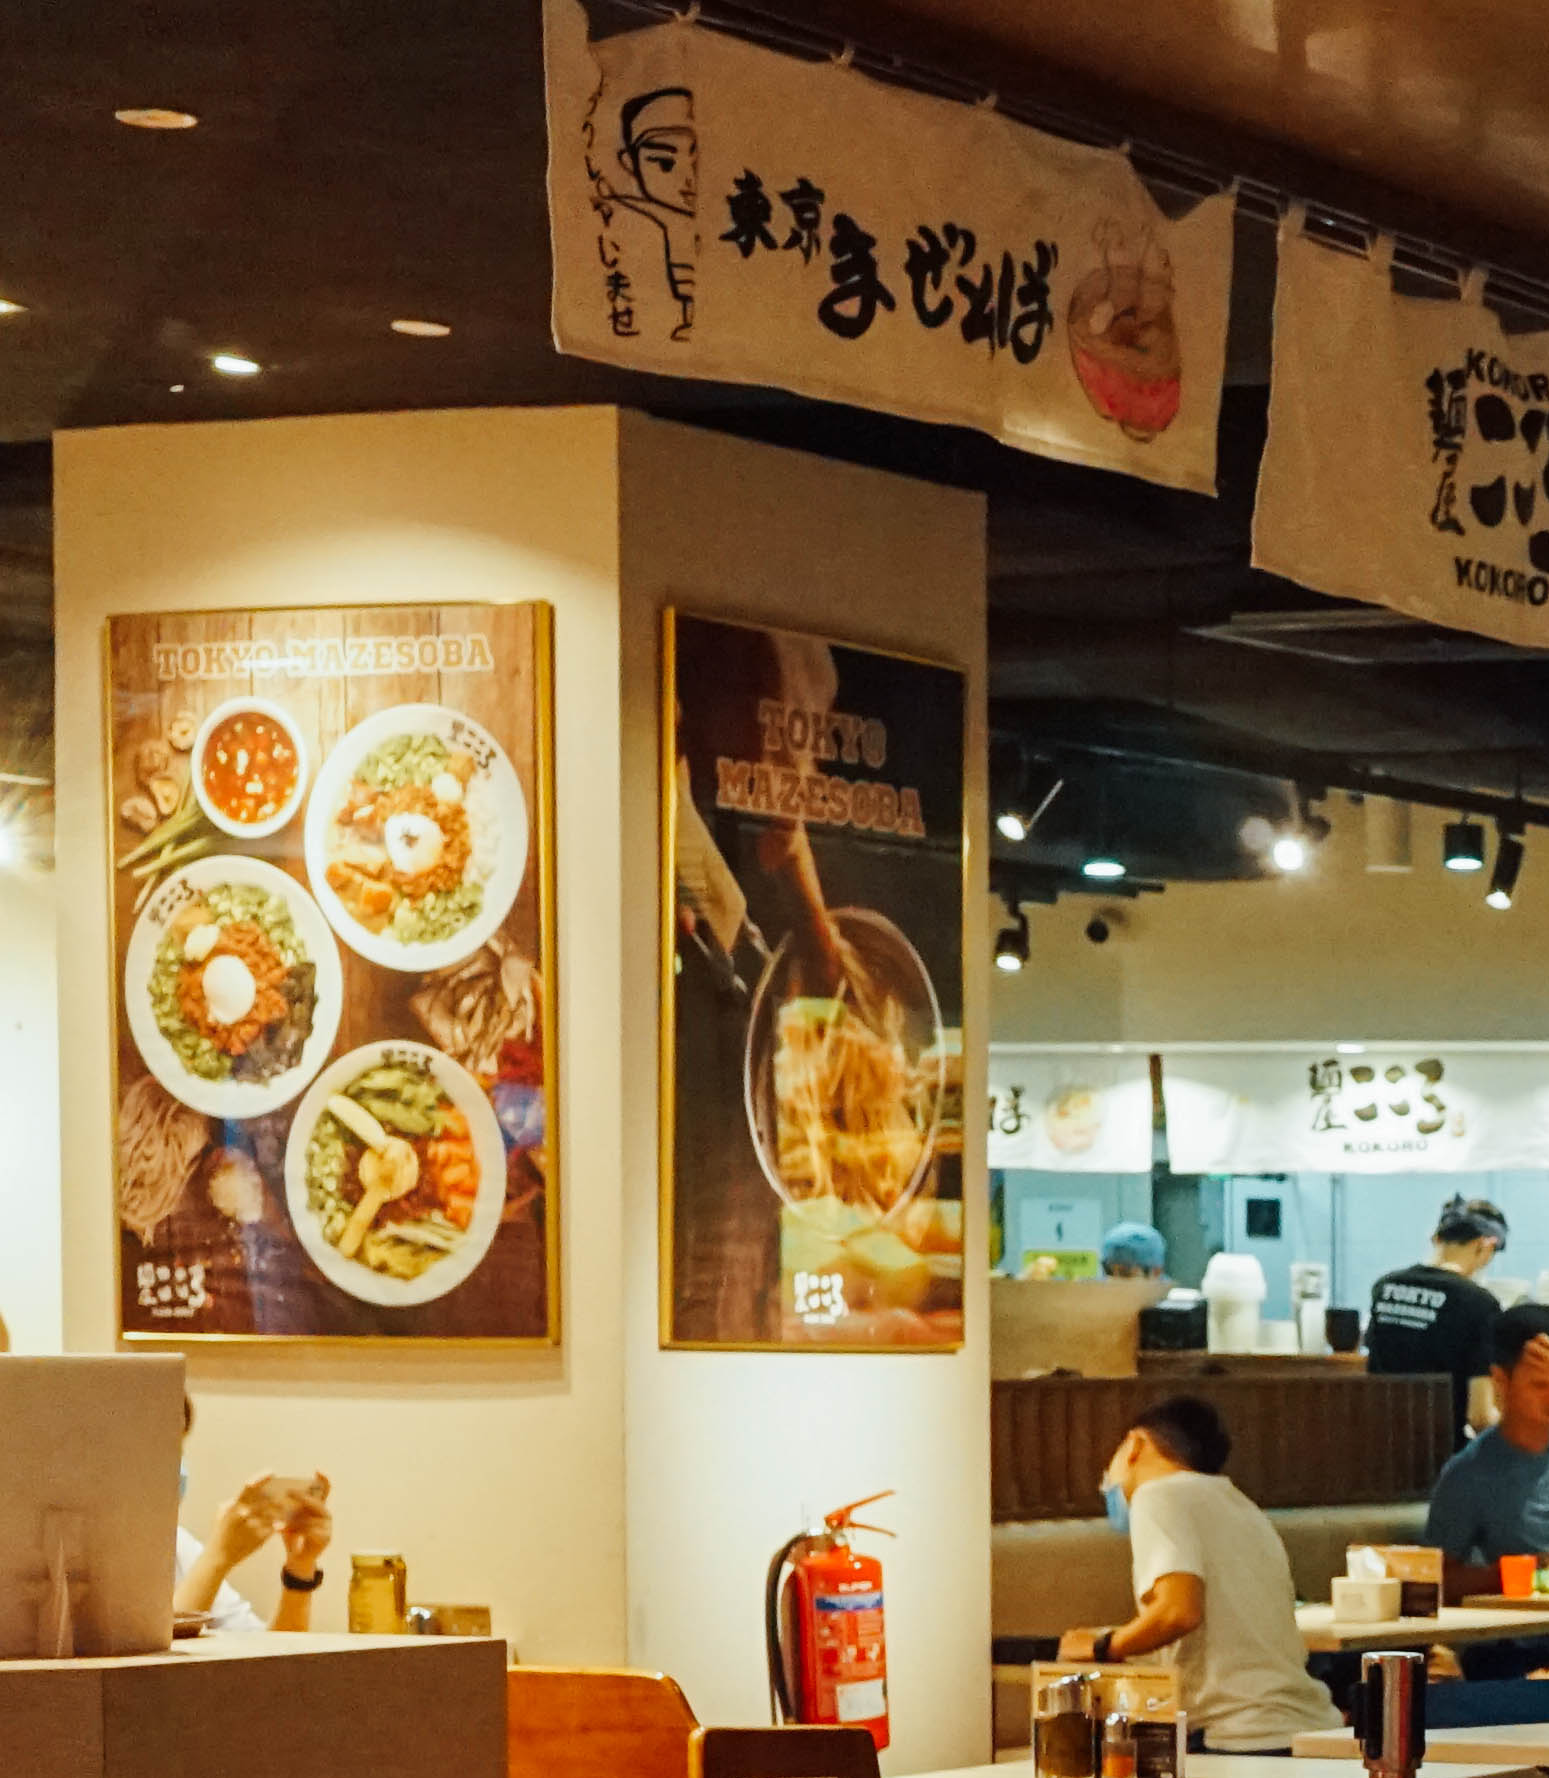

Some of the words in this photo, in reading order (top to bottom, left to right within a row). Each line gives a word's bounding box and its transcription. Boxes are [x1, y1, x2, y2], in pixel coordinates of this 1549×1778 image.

[154, 641, 276, 680] TOKYO
[287, 633, 494, 678] MAZESOBA
[758, 698, 886, 770] TOKYO
[716, 756, 926, 838] MAZESOBA
